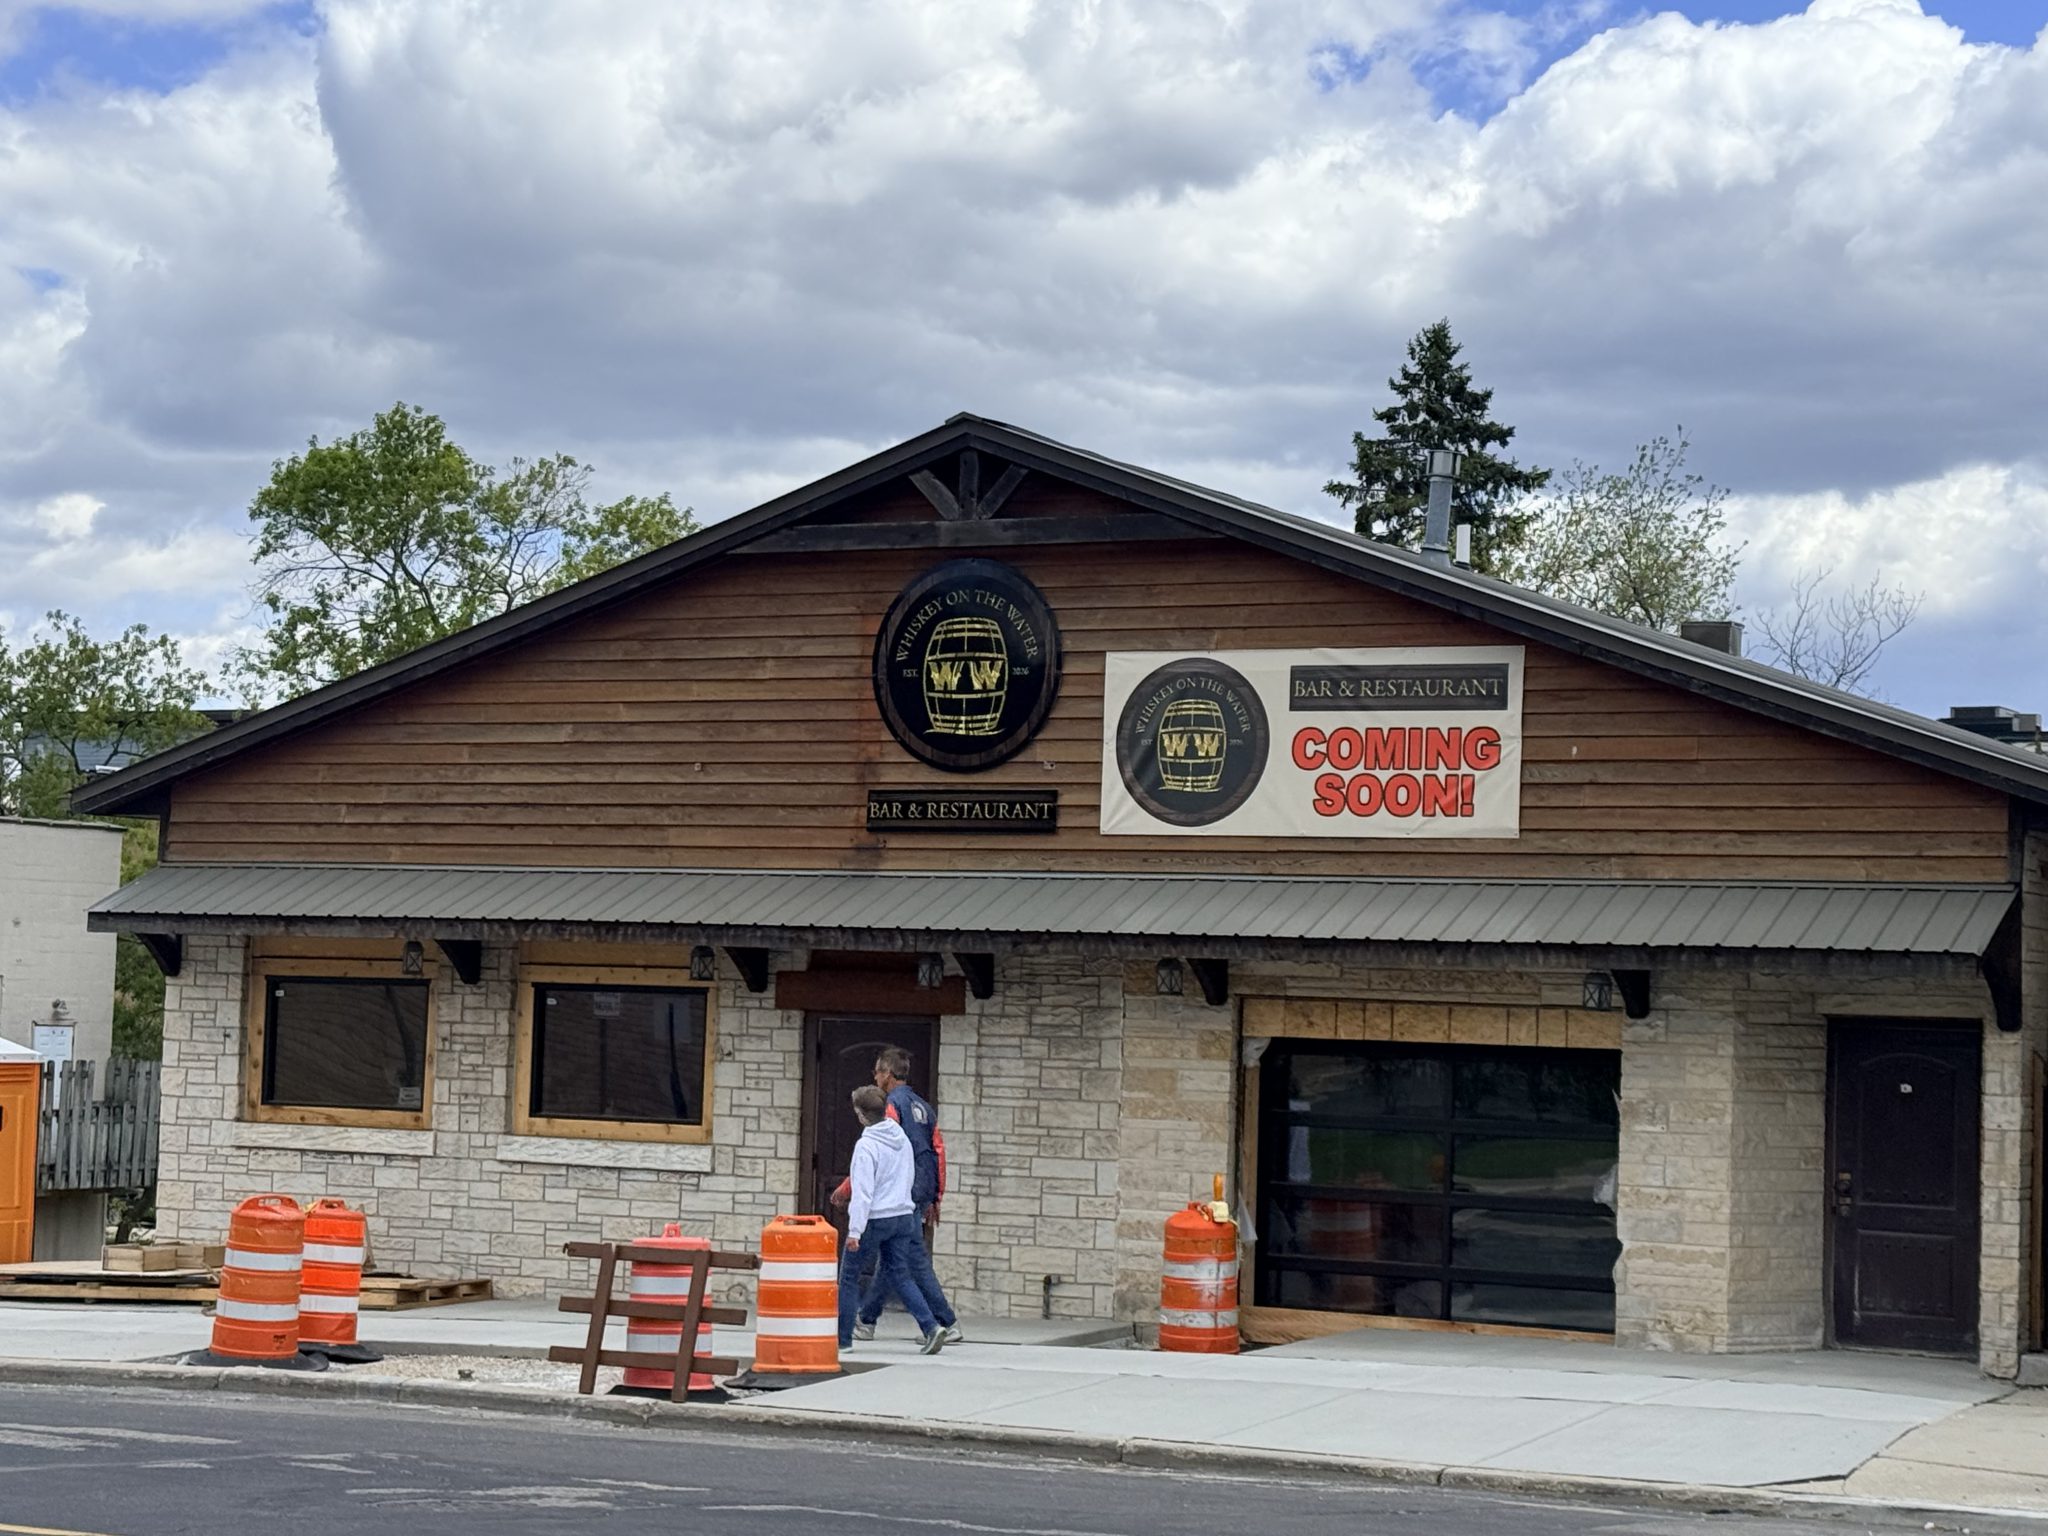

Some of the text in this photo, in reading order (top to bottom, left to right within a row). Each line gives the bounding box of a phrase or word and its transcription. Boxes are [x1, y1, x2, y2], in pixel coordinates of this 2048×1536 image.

[896, 589, 1039, 661] WHISKEY ON THE WATER
[1136, 677, 1251, 734] WHISKEY ON THE WATER
[1294, 678, 1504, 697] BAR & RESTAURANT
[1292, 726, 1501, 771] COMING
[869, 802, 1054, 819] BAR & RESTAURANT
[1313, 773, 1475, 817] SOON!
